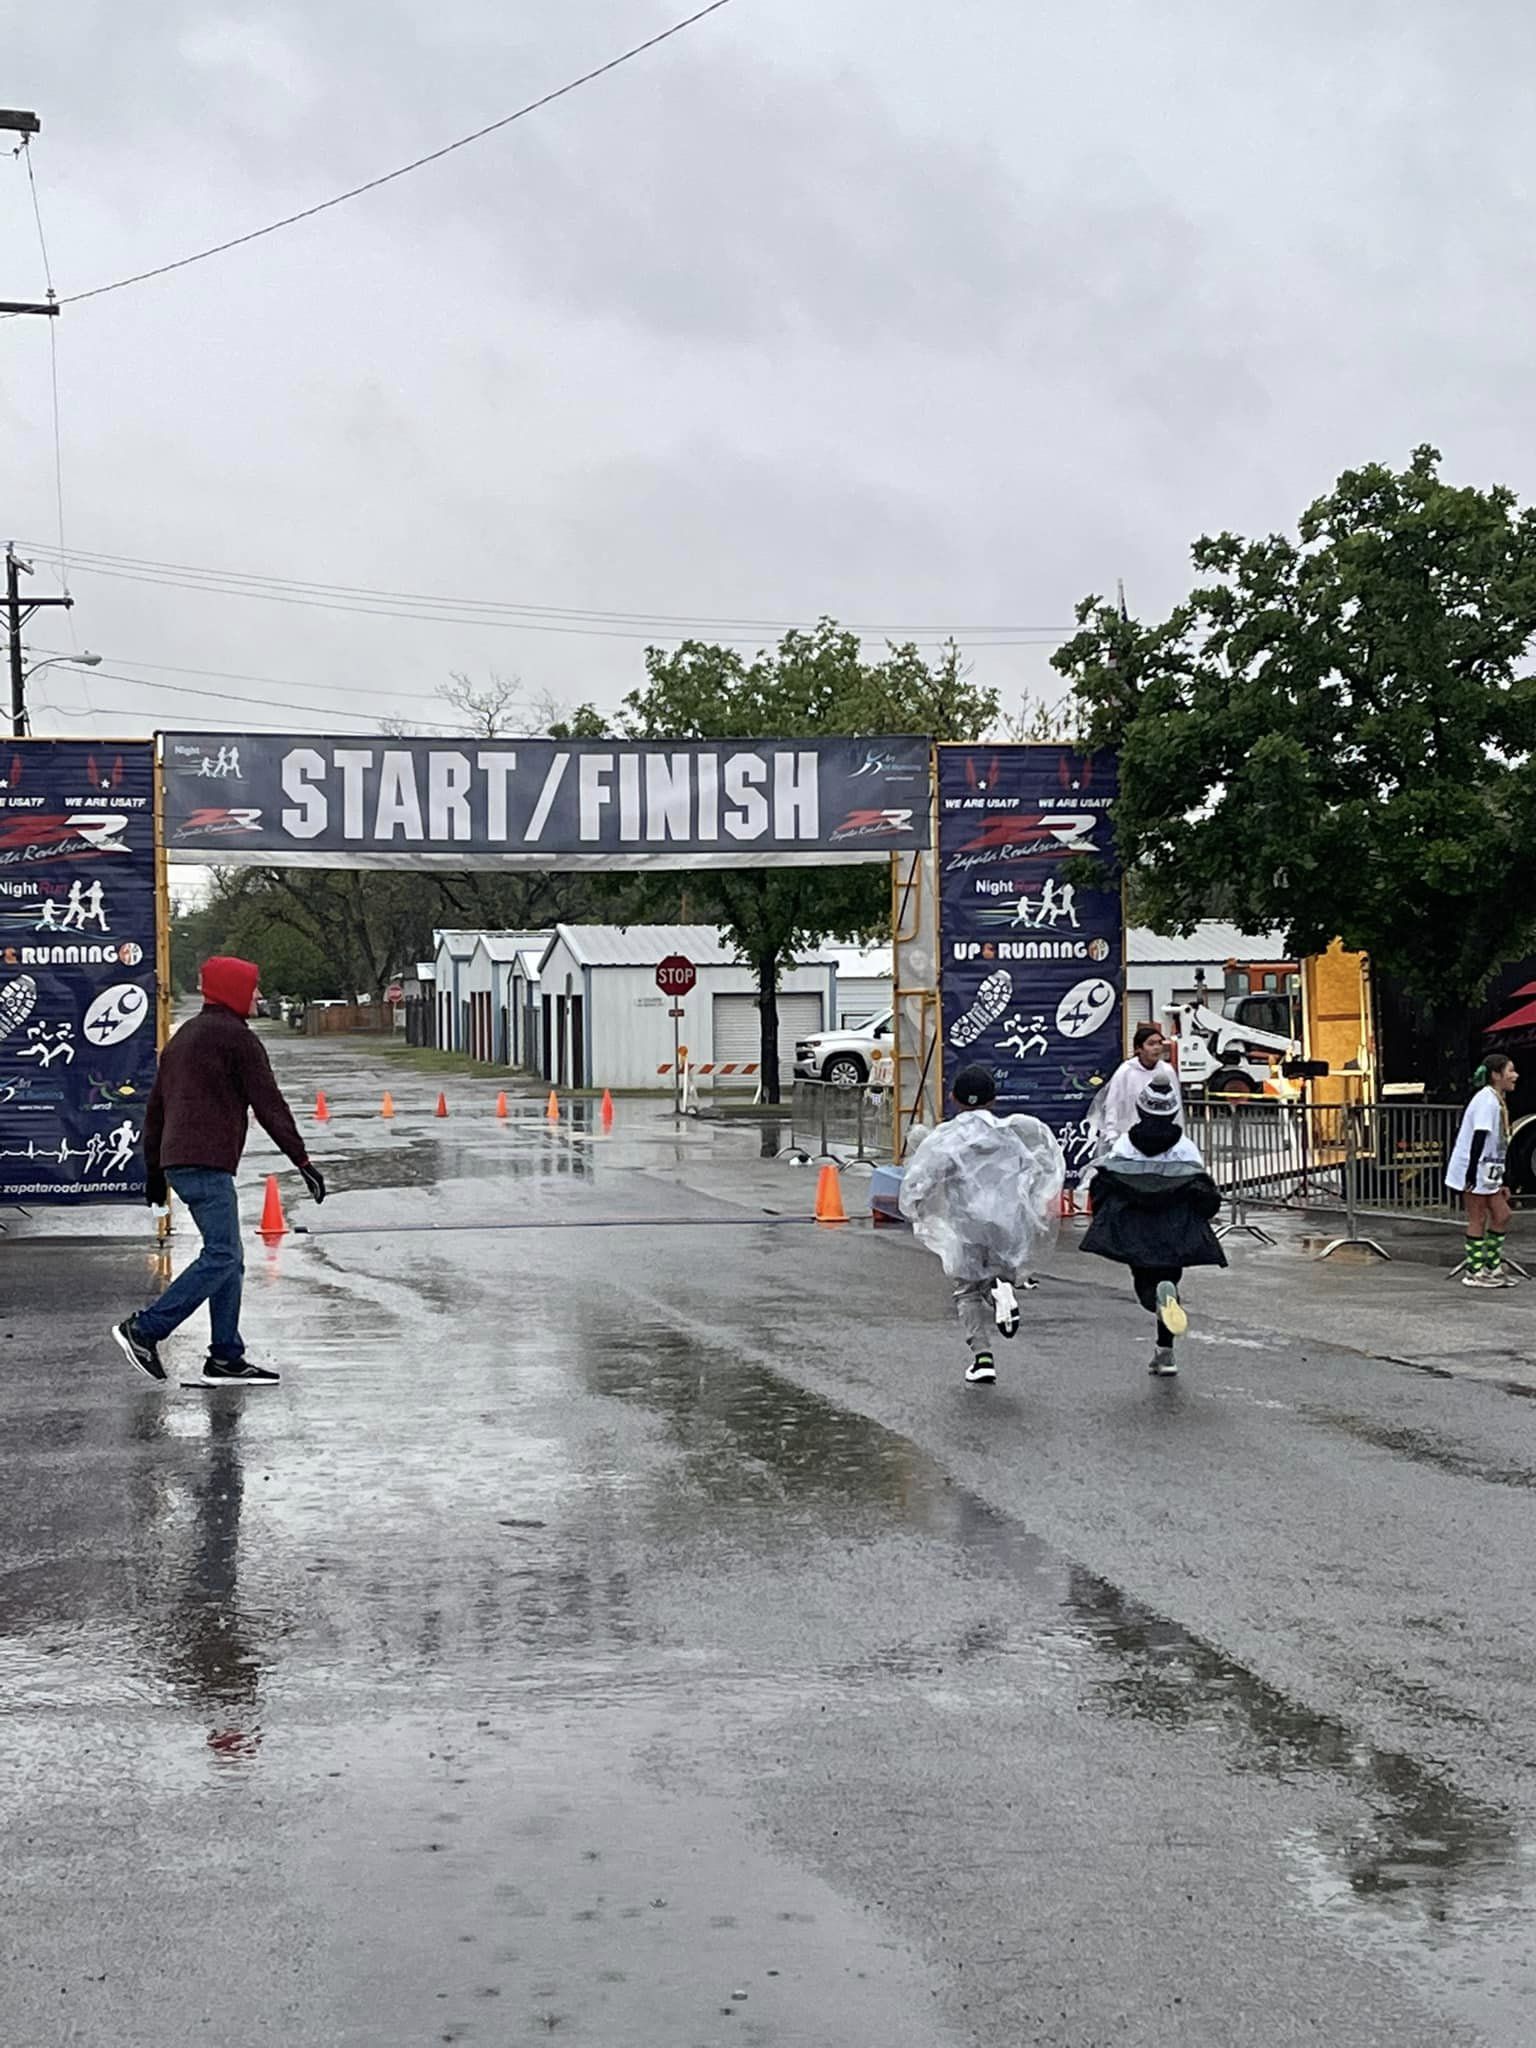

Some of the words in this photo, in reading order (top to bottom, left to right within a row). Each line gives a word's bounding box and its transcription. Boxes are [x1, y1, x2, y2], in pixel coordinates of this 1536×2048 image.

[9, 797, 45, 807] USATF
[65, 797, 83, 807] WE
[84, 797, 108, 807] ARE
[110, 797, 146, 807] USATF
[945, 798, 961, 808] WE
[963, 798, 985, 808] ARE
[986, 798, 1020, 808] USATF
[1038, 798, 1055, 808] WE
[1056, 798, 1078, 808] ARE
[21, 945, 118, 965] RUNNING
[998, 941, 1088, 960] RUNNING
[658, 968, 694, 984] STOP
